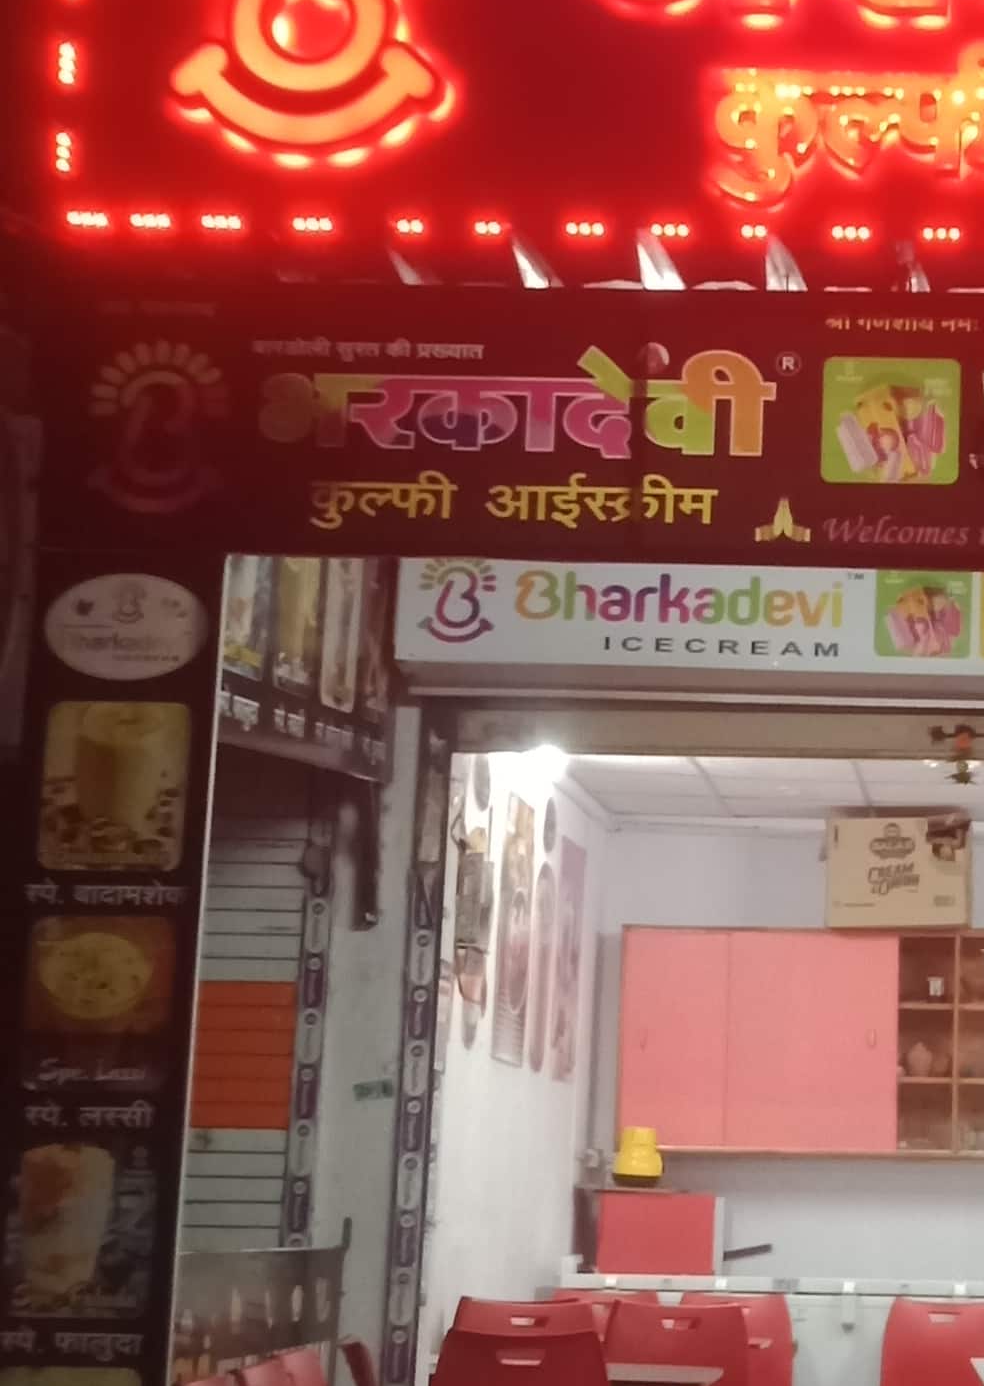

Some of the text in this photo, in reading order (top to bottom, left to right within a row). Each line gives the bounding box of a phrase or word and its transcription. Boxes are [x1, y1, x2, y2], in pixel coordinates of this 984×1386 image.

[309, 470, 459, 529] कुल्फी
[820, 513, 969, 546] Welcomes
[514, 569, 844, 628] Bharkadevi
[603, 636, 841, 657] ICECREAM
